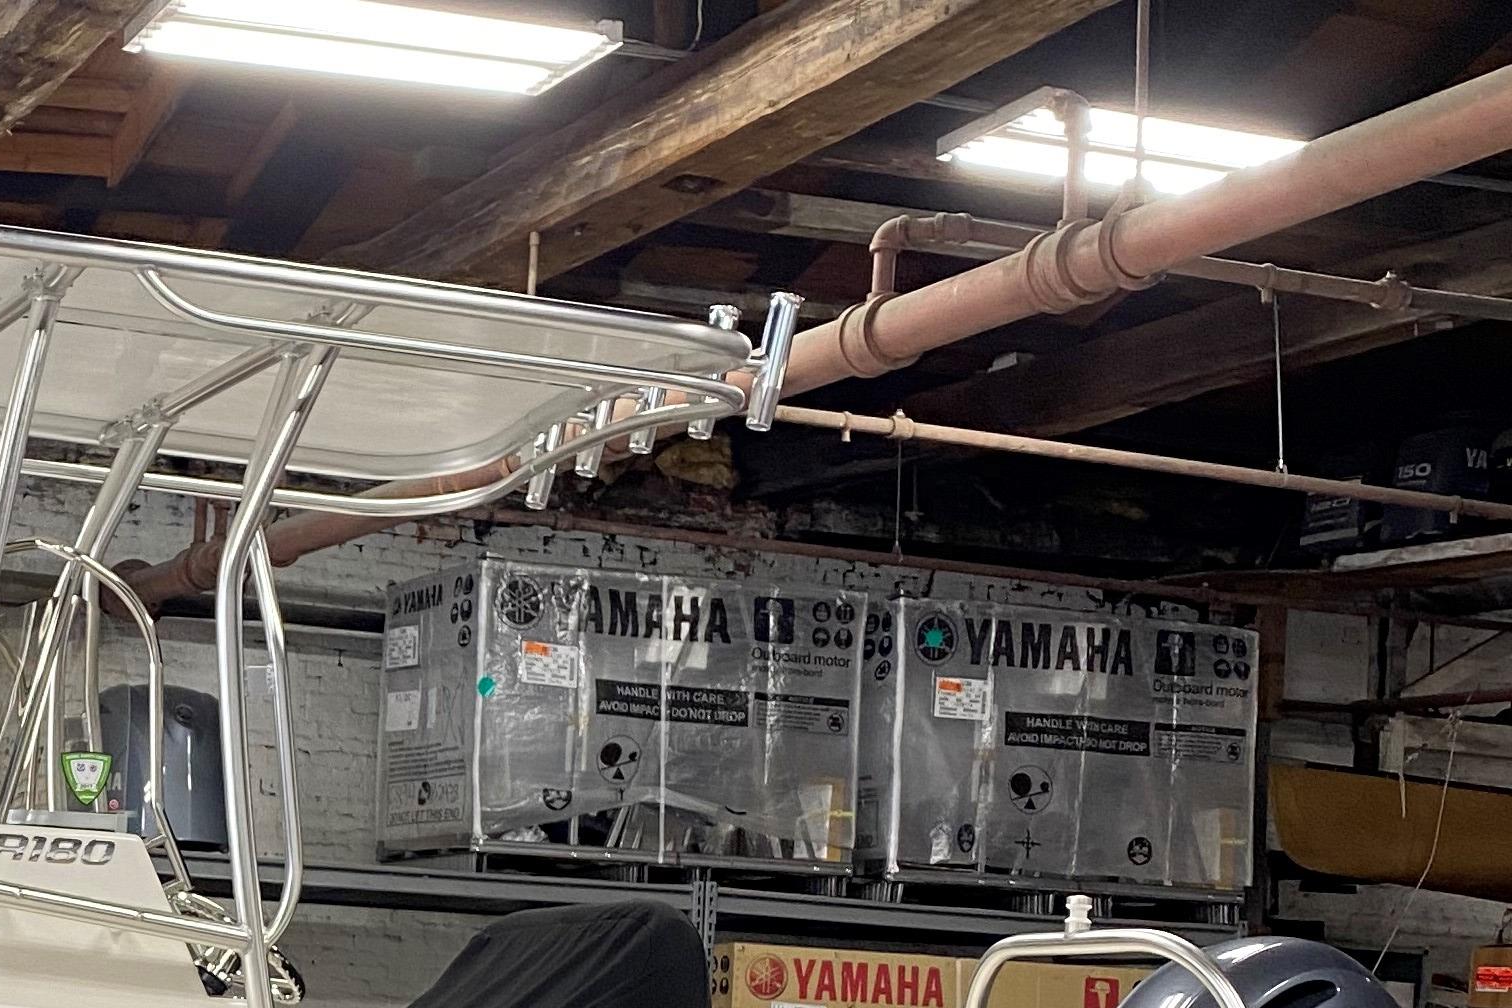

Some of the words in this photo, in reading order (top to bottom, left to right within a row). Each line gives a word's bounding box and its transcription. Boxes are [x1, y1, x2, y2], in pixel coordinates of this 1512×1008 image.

[1398, 463, 1432, 479] 150
[403, 583, 444, 614] YAMAHA
[965, 617, 1133, 677] YAMAHA
[814, 655, 852, 669] motor
[616, 685, 659, 700] HANDLE
[693, 691, 725, 705] CARE
[599, 700, 628, 713] AVOID
[1026, 716, 1072, 730] HANDLE
[1100, 722, 1129, 735] CARE
[1007, 731, 1039, 744] AVOID
[1119, 740, 1148, 753] DROP
[794, 957, 944, 1008] YAMAHA
